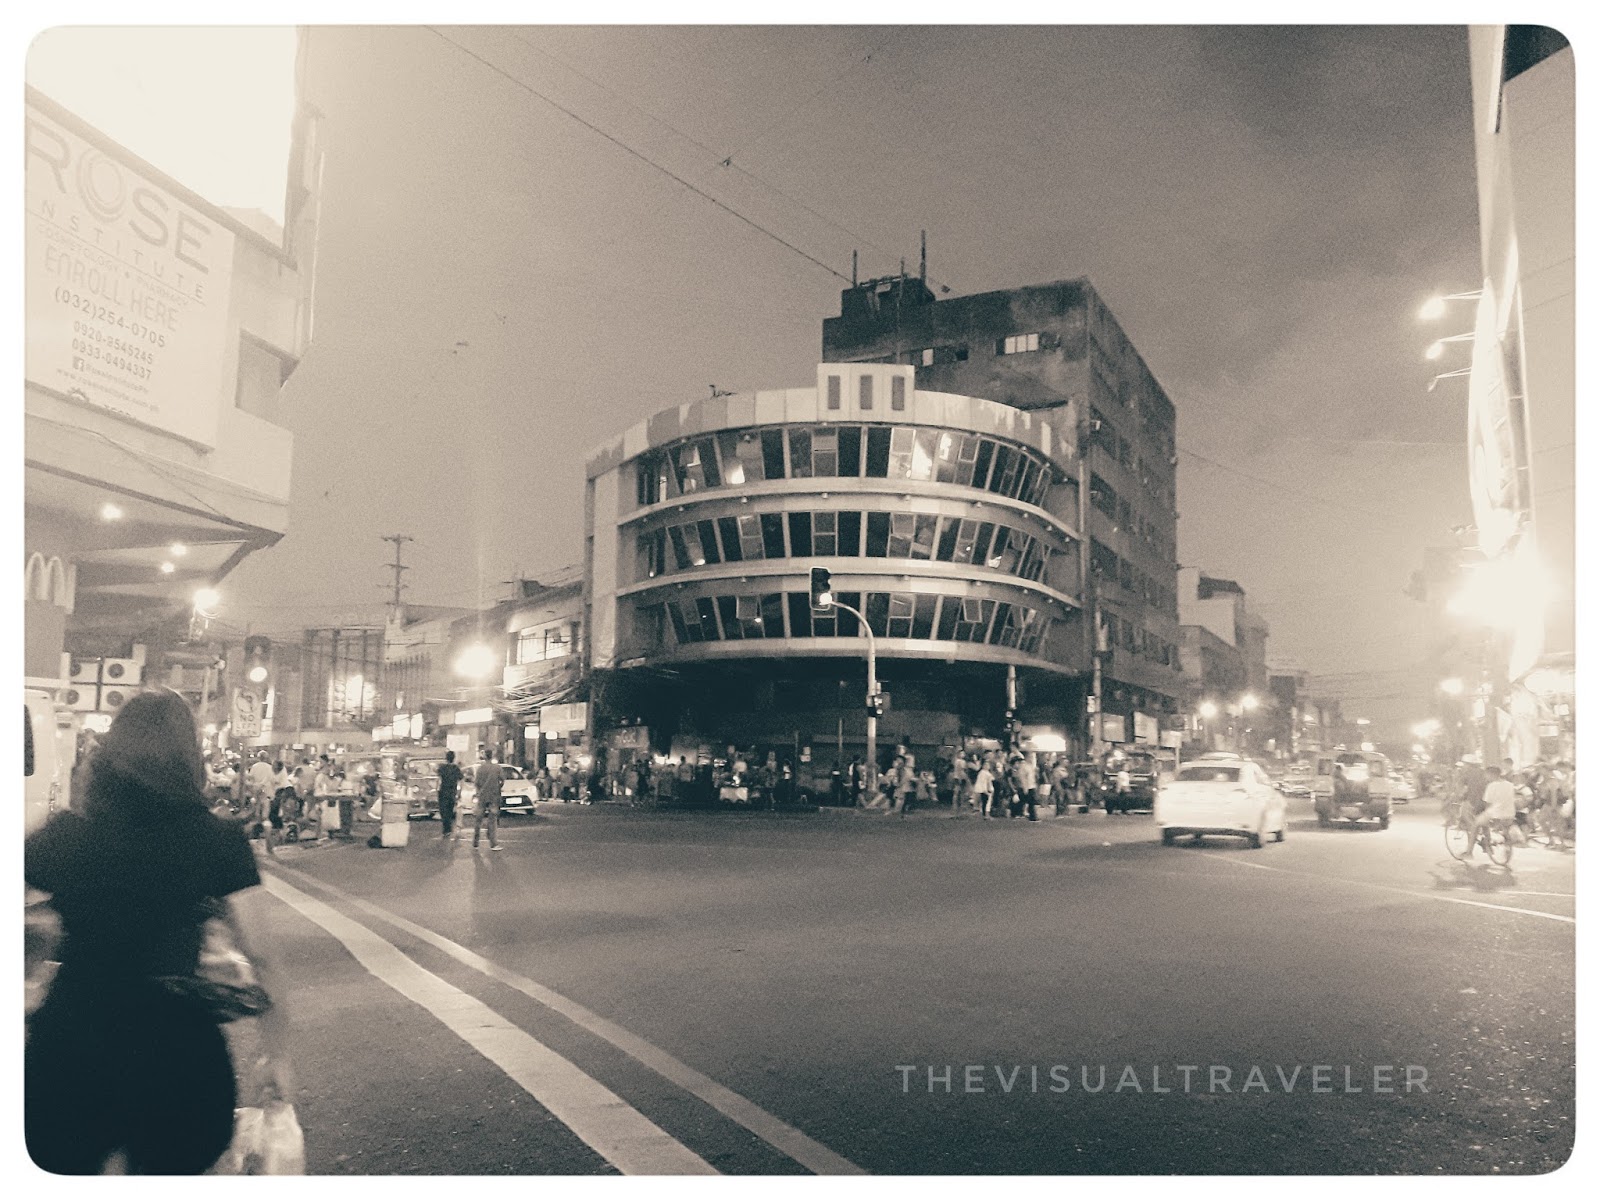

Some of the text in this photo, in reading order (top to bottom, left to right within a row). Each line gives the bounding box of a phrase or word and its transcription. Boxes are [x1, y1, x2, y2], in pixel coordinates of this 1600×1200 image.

[24, 113, 211, 275] ROSE
[54, 286, 166, 348] (032)254-0705
[130, 288, 178, 332] HERE
